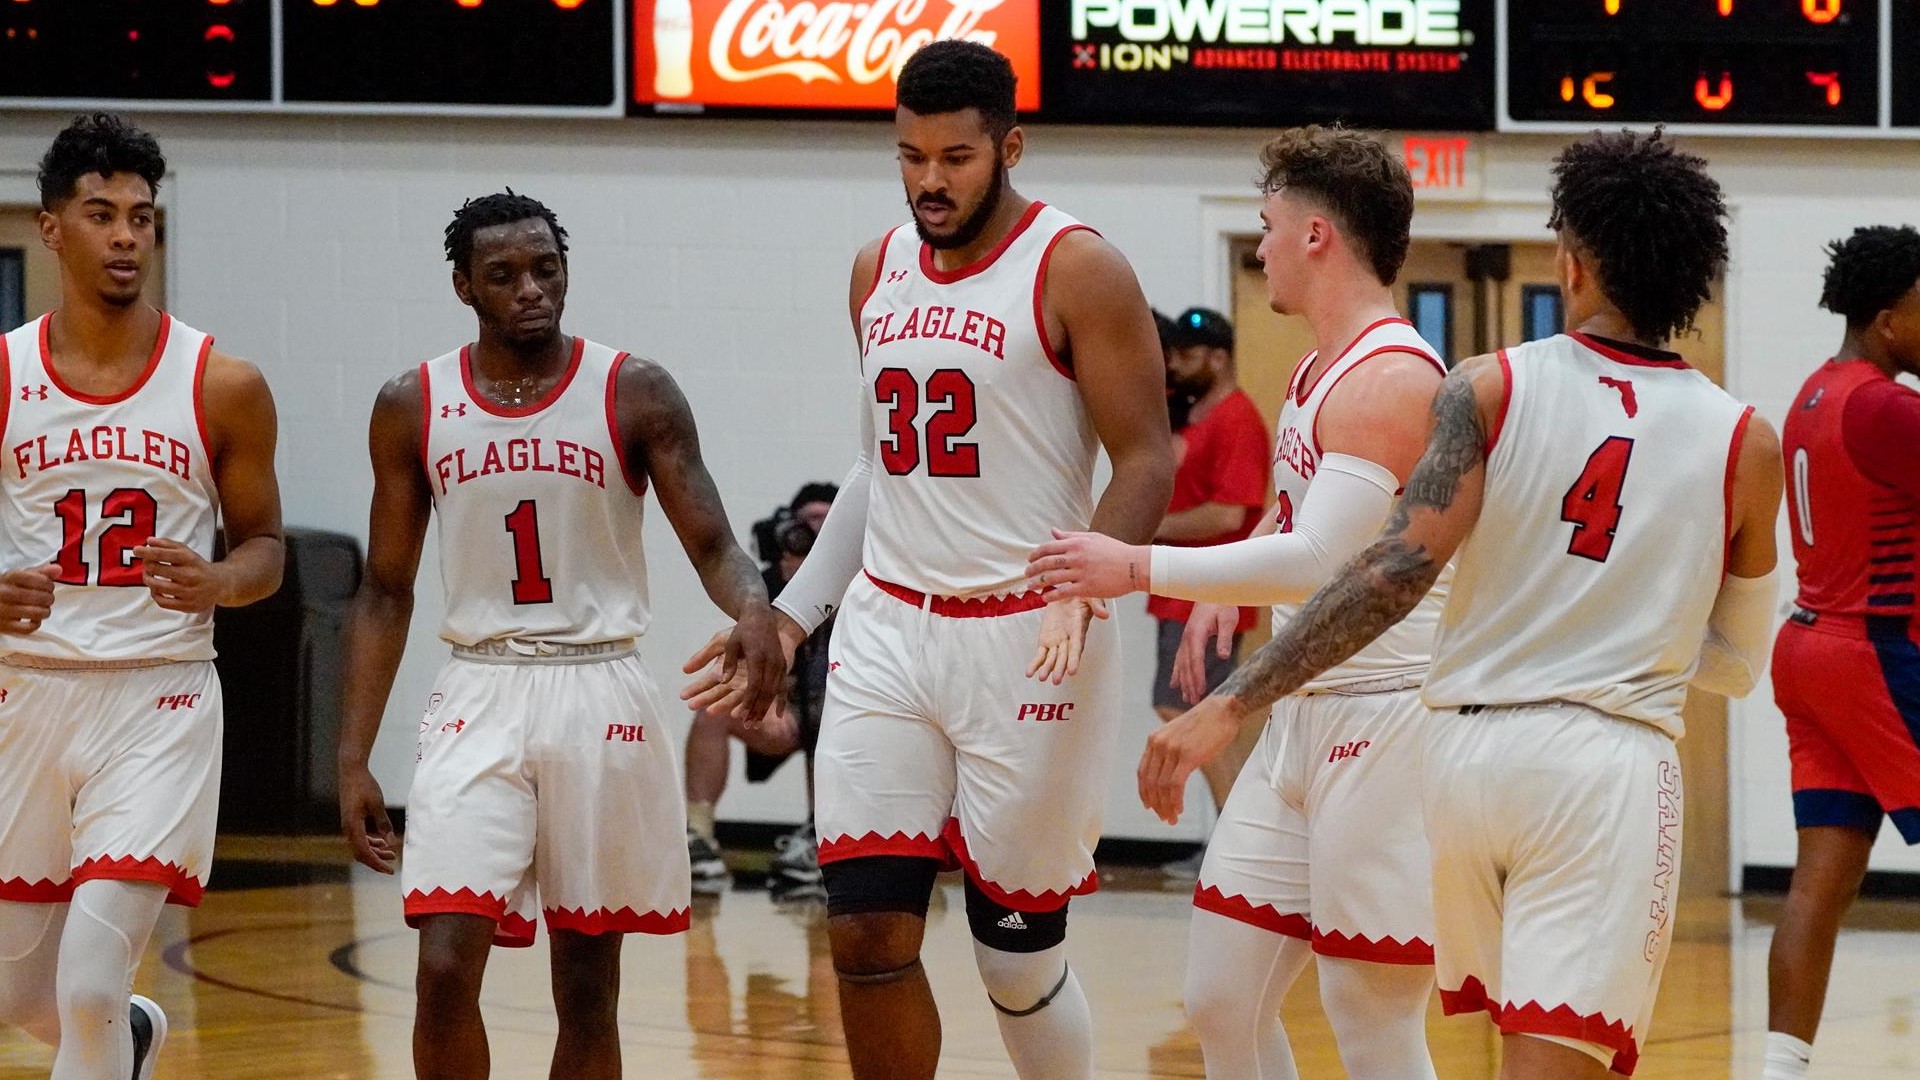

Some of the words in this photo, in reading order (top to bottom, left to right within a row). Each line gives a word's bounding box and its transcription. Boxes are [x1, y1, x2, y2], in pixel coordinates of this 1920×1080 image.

[1071, 0, 1462, 45] POWERADE
[1403, 134, 1470, 189] EXIT
[864, 305, 1007, 361] FLAGLER
[874, 367, 981, 478] 32
[13, 425, 191, 481] FLAGLER
[435, 438, 606, 496] FLAGLER
[1273, 426, 1317, 480] AGLER
[1560, 435, 1635, 564] 4
[1793, 446, 1815, 548] 0
[52, 487, 158, 587] 12
[504, 498, 554, 606] 1
[1017, 702, 1075, 722] PBC
[997, 920, 1028, 930] adidas
